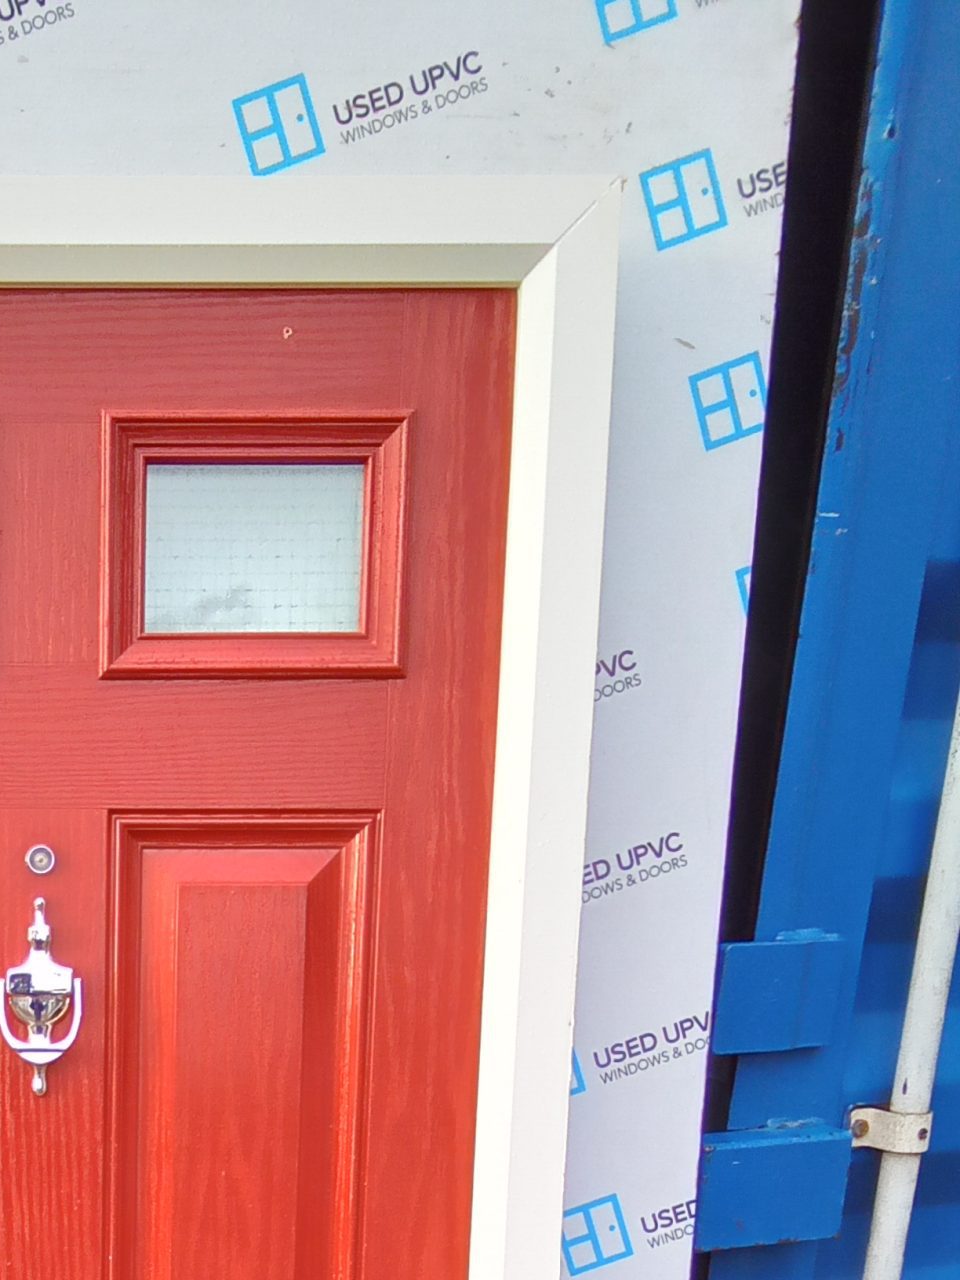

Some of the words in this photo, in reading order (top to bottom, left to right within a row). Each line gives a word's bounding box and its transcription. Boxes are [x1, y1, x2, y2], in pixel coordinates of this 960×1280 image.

[8, 25, 19, 40] &
[21, 3, 75, 35] DOORS
[333, 82, 404, 125] USED
[409, 51, 483, 95] UPVC
[340, 105, 418, 144] WINDOWS
[422, 100, 432, 114] &
[435, 77, 489, 109] DOORS
[737, 161, 786, 198] USE
[743, 193, 783, 217] WIND
[596, 650, 637, 677] VC
[583, 859, 611, 885] ED
[616, 832, 683, 871] UPVC
[581, 878, 623, 904] DOWS
[626, 874, 637, 887] &
[639, 854, 688, 881] DOORS
[593, 1033, 658, 1068] USED
[662, 1011, 709, 1043] UPV
[600, 1051, 670, 1084] WINDOWS
[672, 1047, 682, 1059] &
[647, 1224, 695, 1248] WINDO
